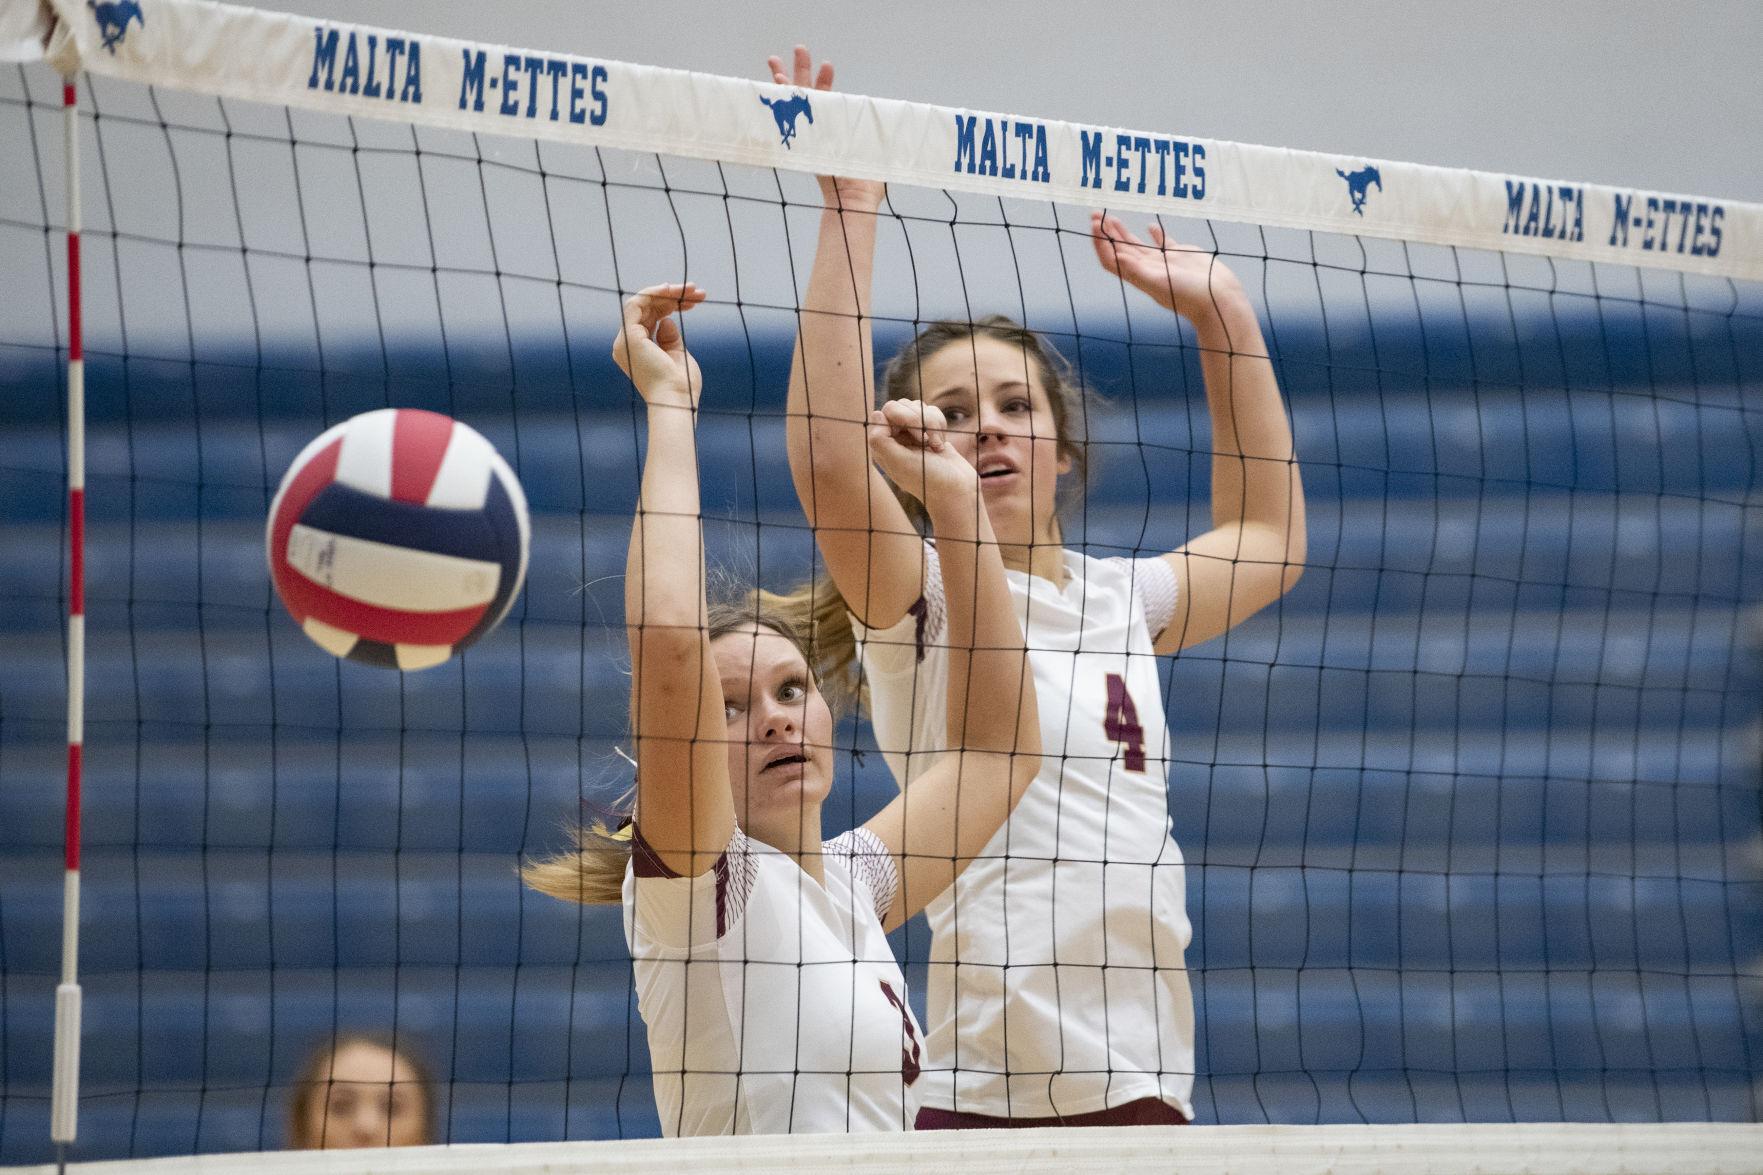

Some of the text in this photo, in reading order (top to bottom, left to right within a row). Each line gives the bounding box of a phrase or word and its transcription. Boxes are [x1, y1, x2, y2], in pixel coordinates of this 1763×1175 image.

[308, 27, 608, 126] MALTA M-ETTES
[954, 114, 1206, 200] MALTA M-ETTES
[1503, 180, 1584, 242] MALTA
[1103, 673, 1146, 773] 4
